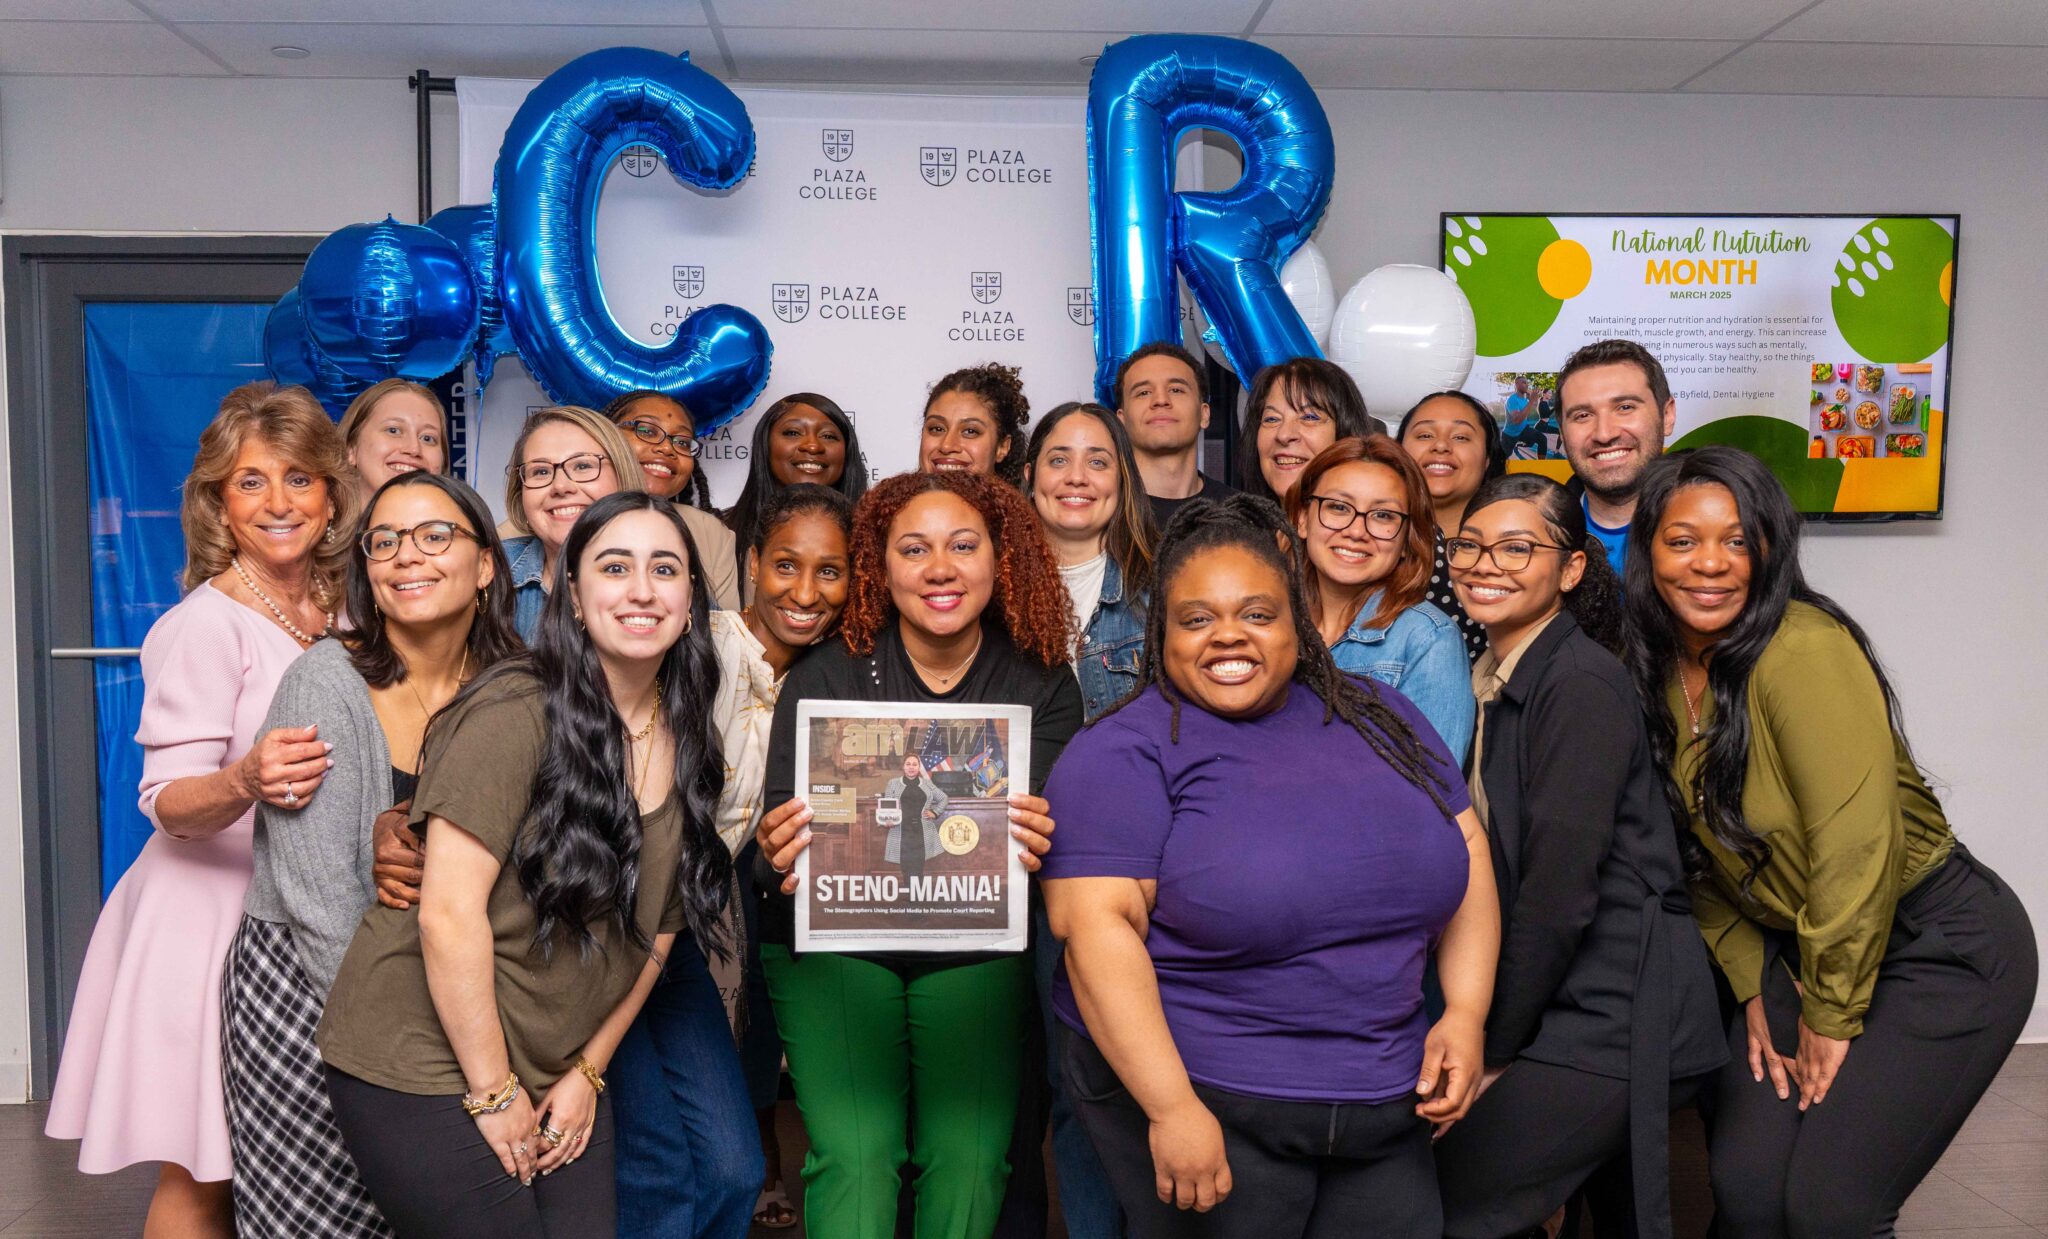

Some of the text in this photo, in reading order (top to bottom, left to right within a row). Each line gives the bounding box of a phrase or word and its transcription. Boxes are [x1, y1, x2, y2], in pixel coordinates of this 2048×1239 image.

[926, 153, 934, 161] 19
[968, 150, 1025, 165] PLAZA
[814, 169, 866, 182] PLAZA
[942, 169, 951, 177] 16
[966, 168, 1052, 184] COLLEGE
[799, 186, 877, 201] COLLEGE
[1087, 33, 1335, 405] R
[494, 46, 774, 435] C
[1612, 227, 1811, 254] National Nutrition
[1645, 259, 1758, 285] MONTH
[778, 289, 787, 297] 19
[820, 286, 879, 302] PLAZA
[1073, 293, 1081, 301] 19
[1670, 291, 1732, 299] MARCH 2025
[795, 306, 804, 314] 16
[819, 305, 907, 321] COLLEGE
[962, 311, 1015, 324] PLAZA
[1589, 315, 1824, 326] Maintaining proper nutrition and hydration is essential for
[948, 328, 1025, 342] COLLEGE
[1583, 327, 1827, 338] overall health, muscle growth, and energy. This can increase
[1662, 341, 1671, 349] in
[1672, 341, 1713, 349] numerous
[1715, 342, 1736, 351] ways
[1737, 341, 1757, 349] such
[1769, 341, 1808, 351] mentally,
[1663, 353, 1709, 363] physically.
[1709, 353, 1727, 363] Stay
[1728, 353, 1762, 363] healthy,
[1775, 353, 1789, 362] the
[1790, 353, 1816, 363] things
[1680, 368, 1696, 376] you
[1714, 366, 1725, 375] be
[1726, 366, 1759, 376] healthy.
[1680, 390, 1711, 400] Byfield,
[1713, 390, 1740, 399] Dental
[1741, 390, 1775, 400] Hygiene
[705, 445, 749, 460] LLEG
[812, 785, 836, 793] INSIDE
[816, 874, 1001, 902] STENO-MANIA!
[873, 907, 889, 915] Using
